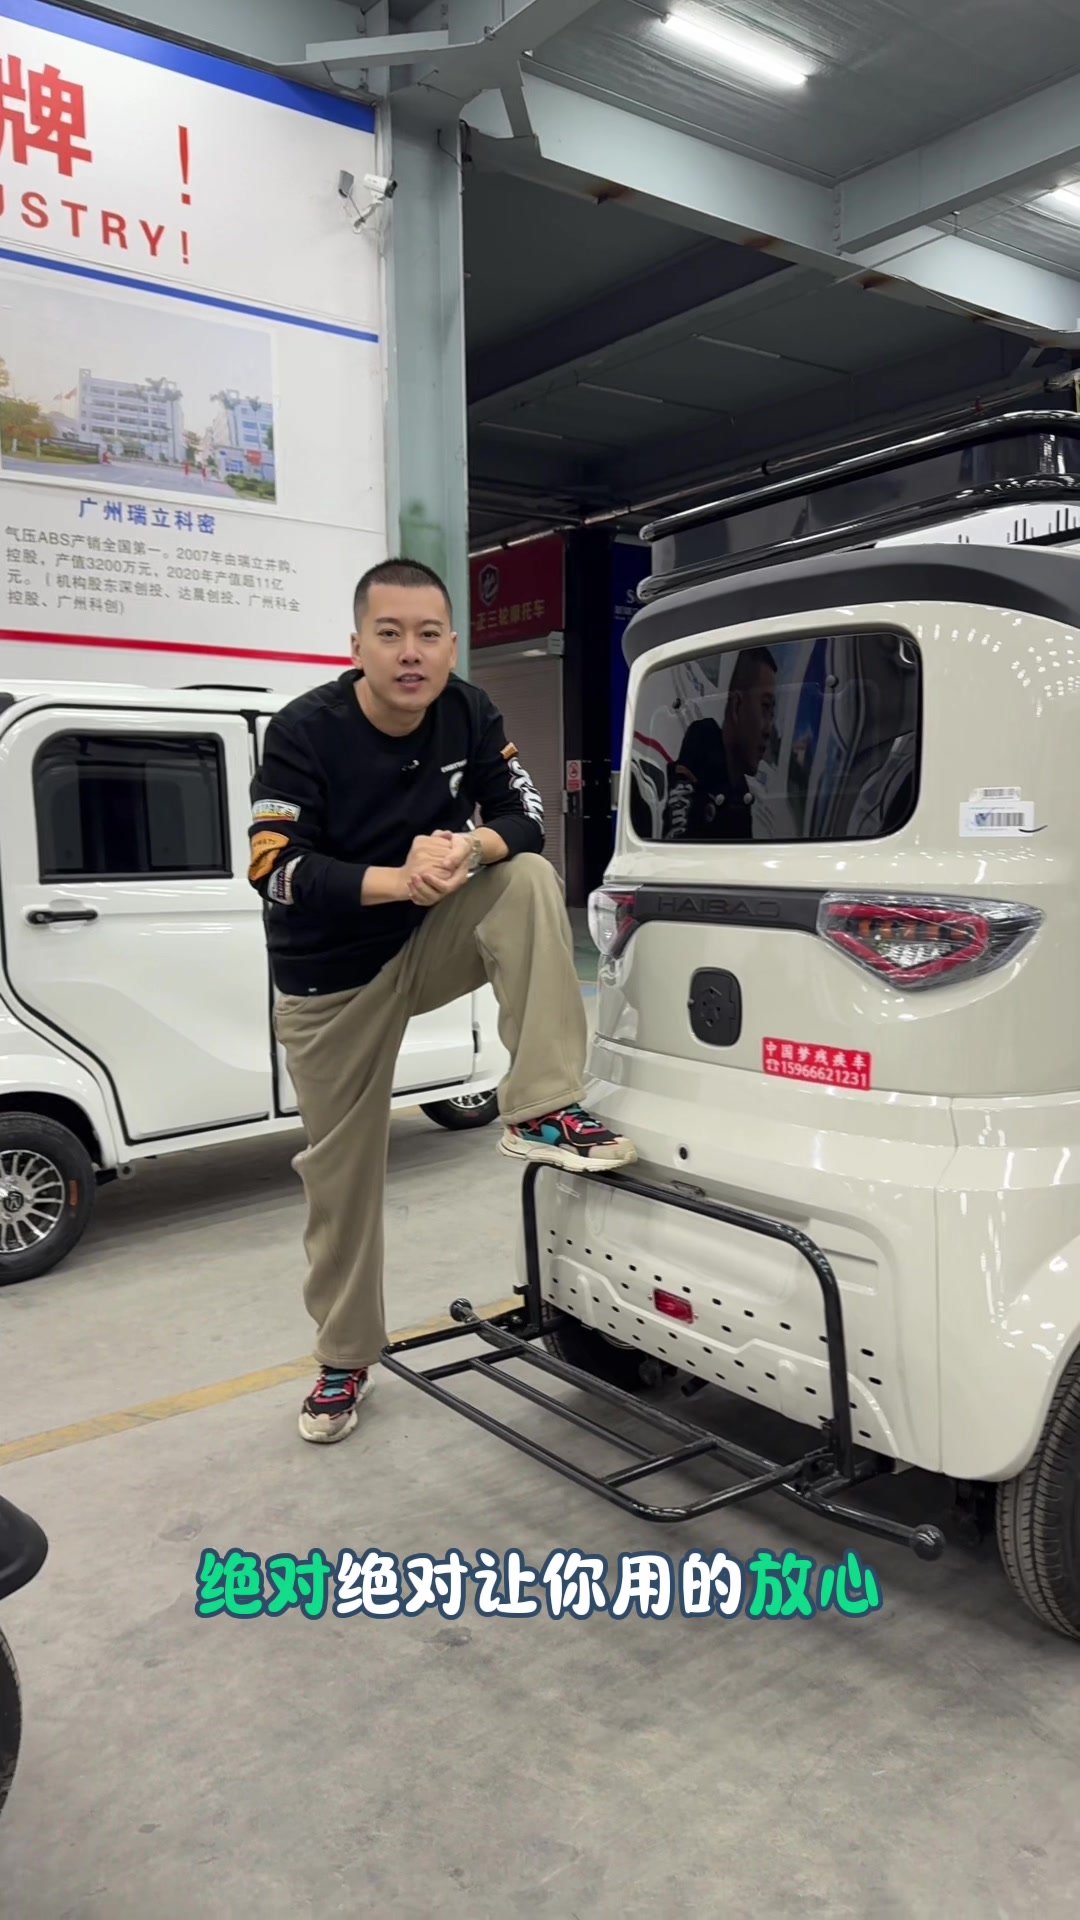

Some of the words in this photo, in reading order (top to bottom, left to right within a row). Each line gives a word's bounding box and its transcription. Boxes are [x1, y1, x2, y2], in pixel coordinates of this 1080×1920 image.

[0, 54, 92, 177] 牌
[0, 184, 190, 265] STRY!
[79, 498, 216, 535] 广州瑞立科密
[658, 896, 780, 919] HAIBAO
[765, 1040, 867, 1072] 中国梦残疾车
[781, 1060, 868, 1087] 15966621231
